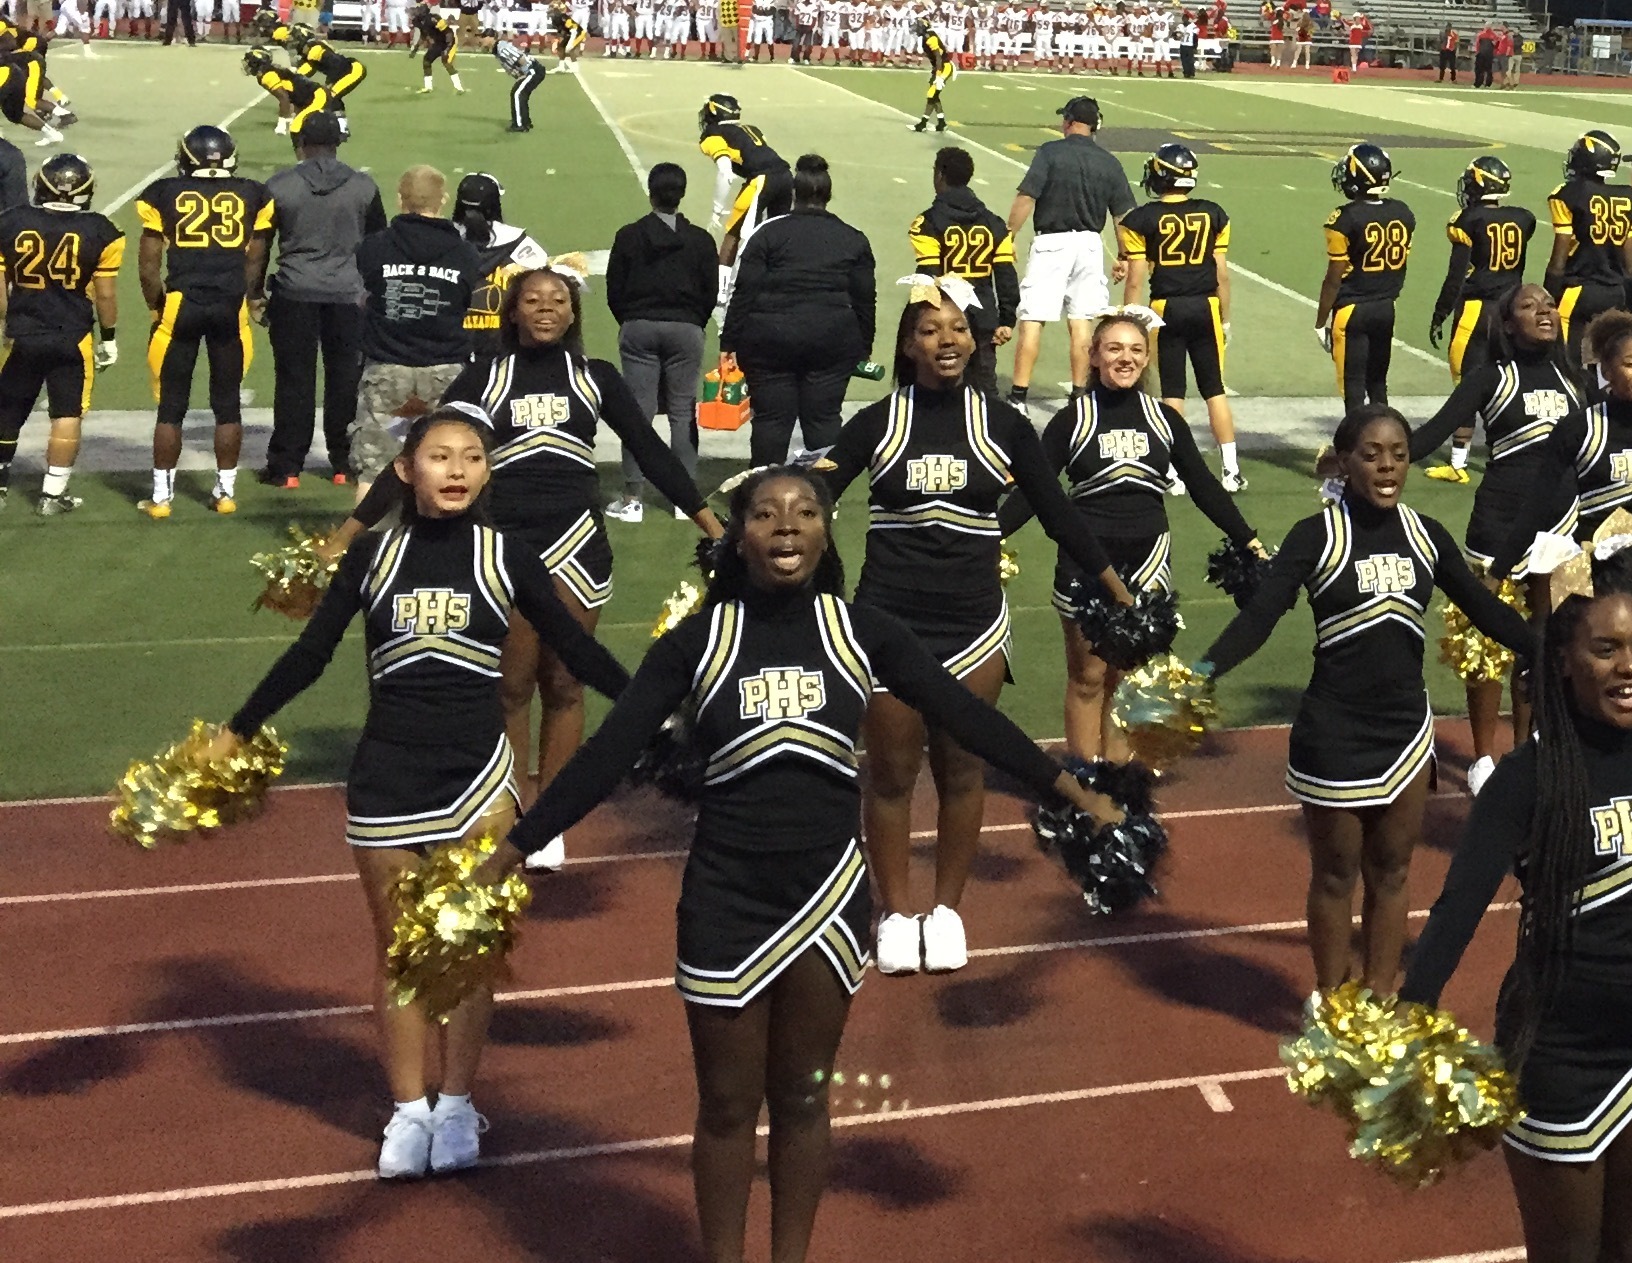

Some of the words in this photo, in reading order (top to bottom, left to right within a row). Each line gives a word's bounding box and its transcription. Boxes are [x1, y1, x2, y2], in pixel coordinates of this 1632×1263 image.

[951, 16, 963, 27] 65
[175, 191, 244, 247] 23
[1159, 212, 1210, 266] 27
[1589, 195, 1631, 245] 35
[15, 230, 80, 289] 24
[944, 225, 994, 278] 22
[1361, 220, 1408, 272] 28
[1486, 222, 1521, 271] 19
[382, 264, 415, 278] BACK
[417, 265, 427, 276] 2
[429, 266, 460, 284] BACK
[511, 393, 570, 430] PHS
[1523, 390, 1569, 418] PHS
[1098, 429, 1150, 460] PHS
[907, 455, 967, 494] PHS
[1355, 554, 1416, 595] PHS
[392, 588, 471, 636] PHS
[739, 667, 826, 722] PHS
